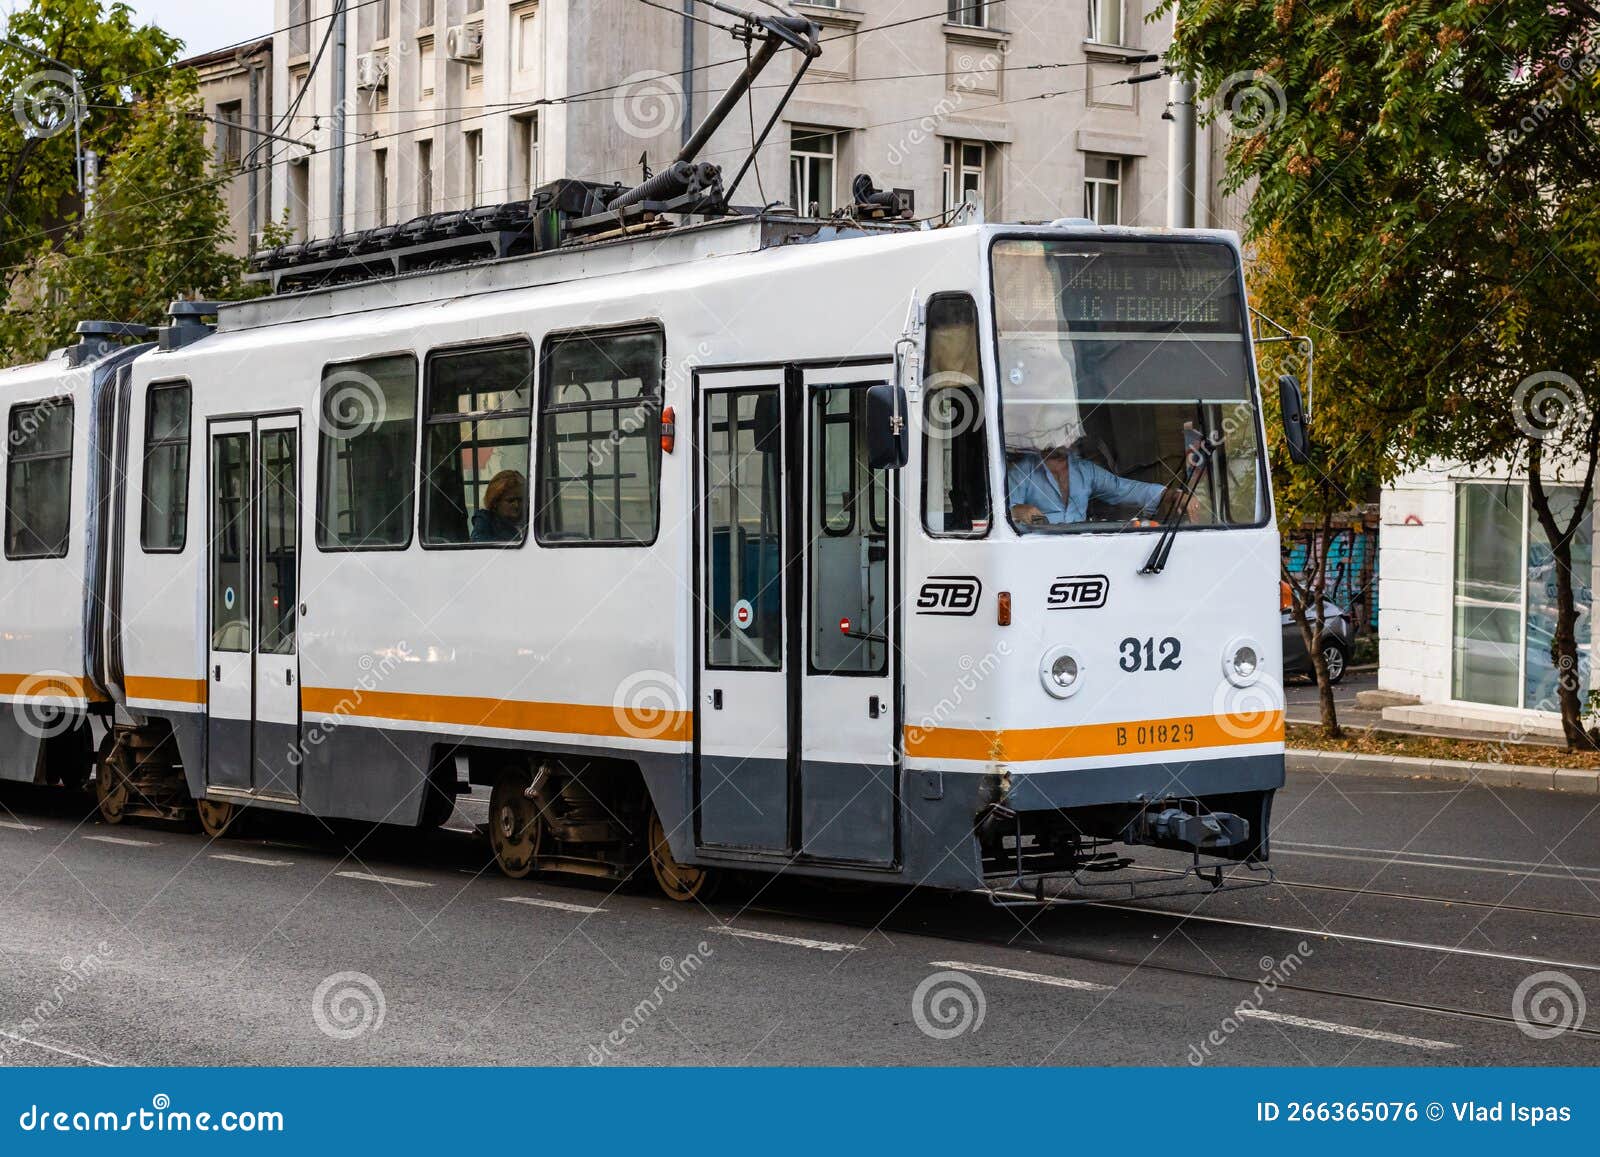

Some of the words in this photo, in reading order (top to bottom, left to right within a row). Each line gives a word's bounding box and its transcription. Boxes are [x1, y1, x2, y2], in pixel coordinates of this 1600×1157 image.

[1115, 295, 1220, 322] FEBRUARIE
[915, 581, 977, 609] STB
[1046, 579, 1104, 606] STB
[1119, 637, 1182, 673] 312
[1116, 727, 1128, 746] B
[1137, 724, 1194, 745] 01829
